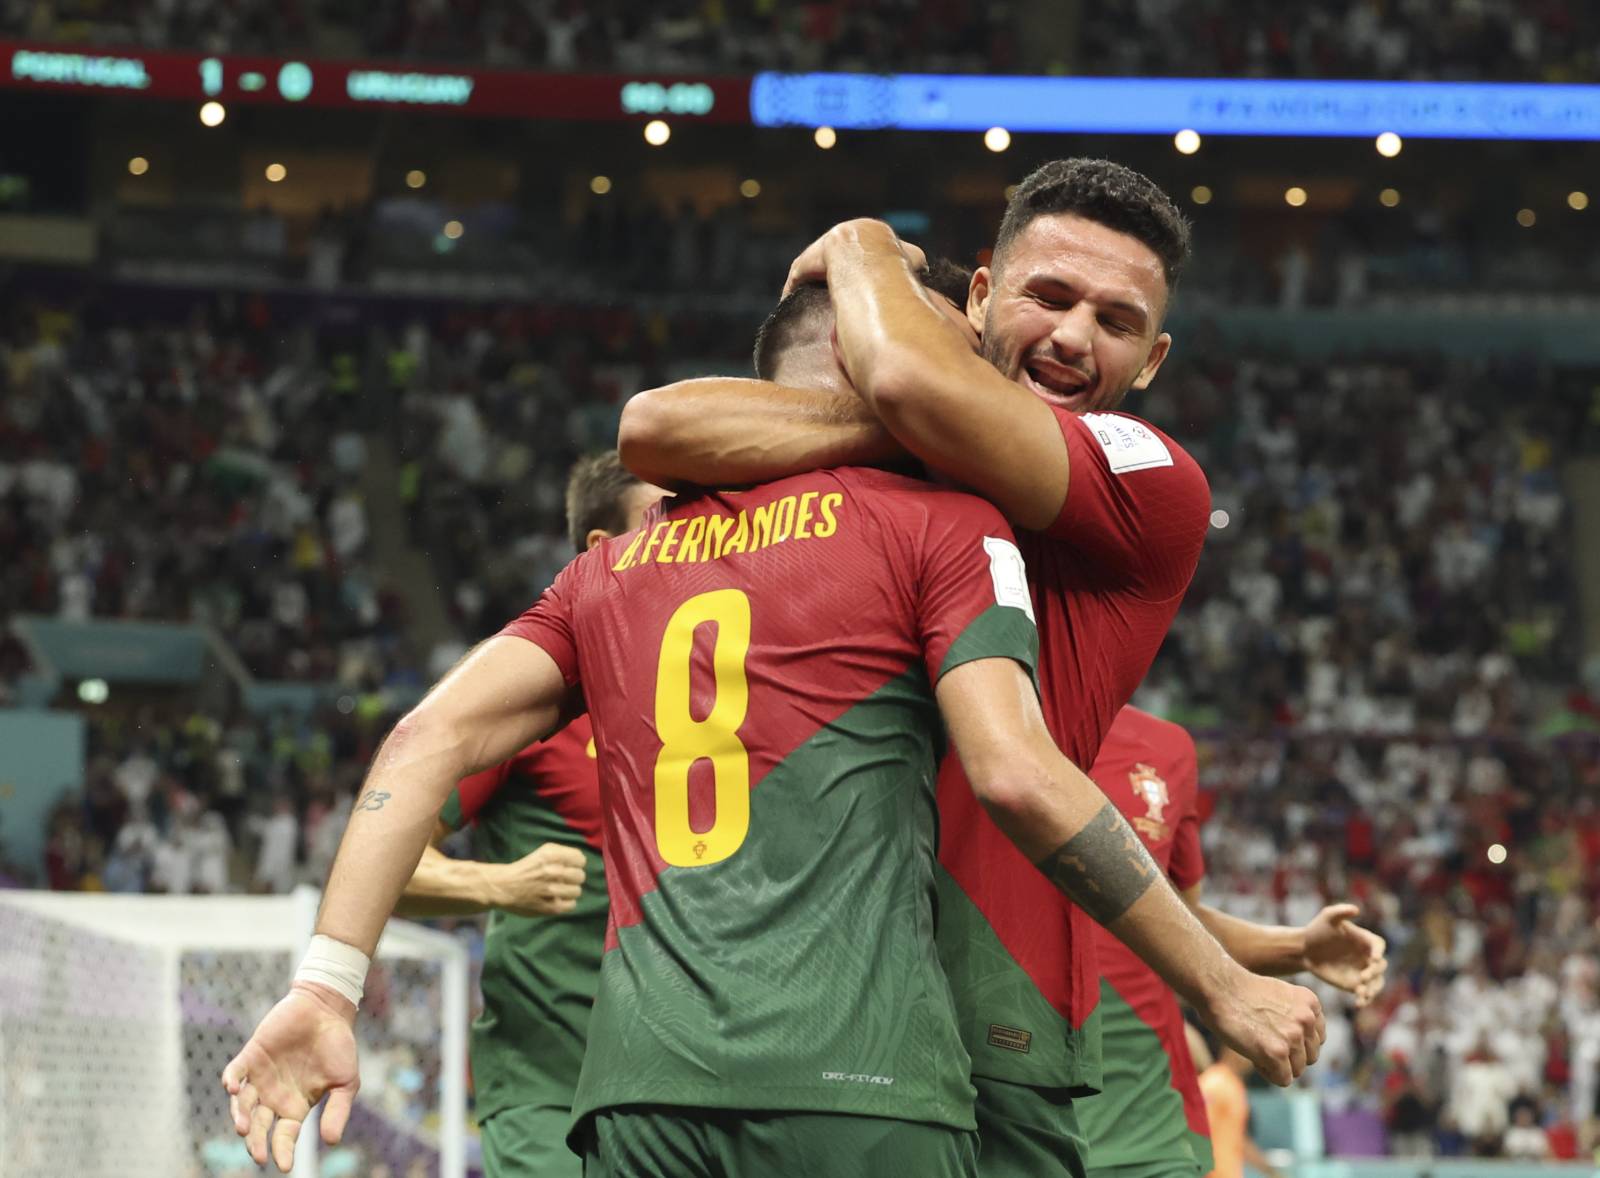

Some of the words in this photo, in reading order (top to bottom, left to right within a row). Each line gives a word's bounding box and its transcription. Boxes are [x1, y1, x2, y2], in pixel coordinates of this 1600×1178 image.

[12, 50, 149, 88] PORTUGAL
[199, 58, 223, 96] 1
[277, 61, 313, 101] 0
[347, 70, 474, 105] URUGUAY
[654, 588, 751, 867] 8
